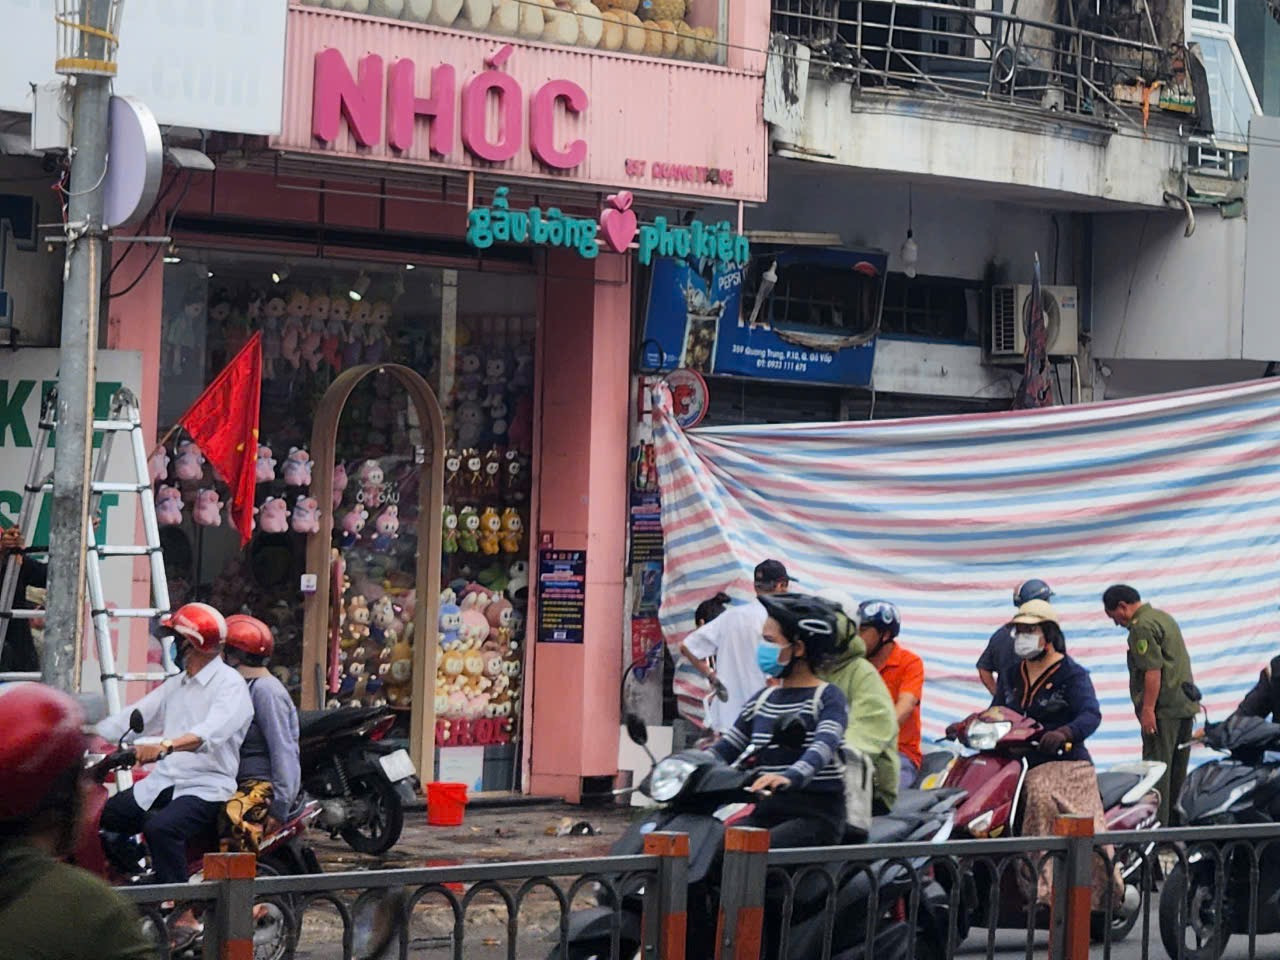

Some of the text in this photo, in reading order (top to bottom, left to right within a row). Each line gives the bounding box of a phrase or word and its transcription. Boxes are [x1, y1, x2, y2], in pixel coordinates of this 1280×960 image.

[467, 186, 527, 248] gấu
[528, 207, 598, 258] bông
[639, 216, 690, 267] phụ
[718, 270, 742, 290] PEPSI
[744, 346, 766, 359] Quang
[783, 360, 794, 371] 111
